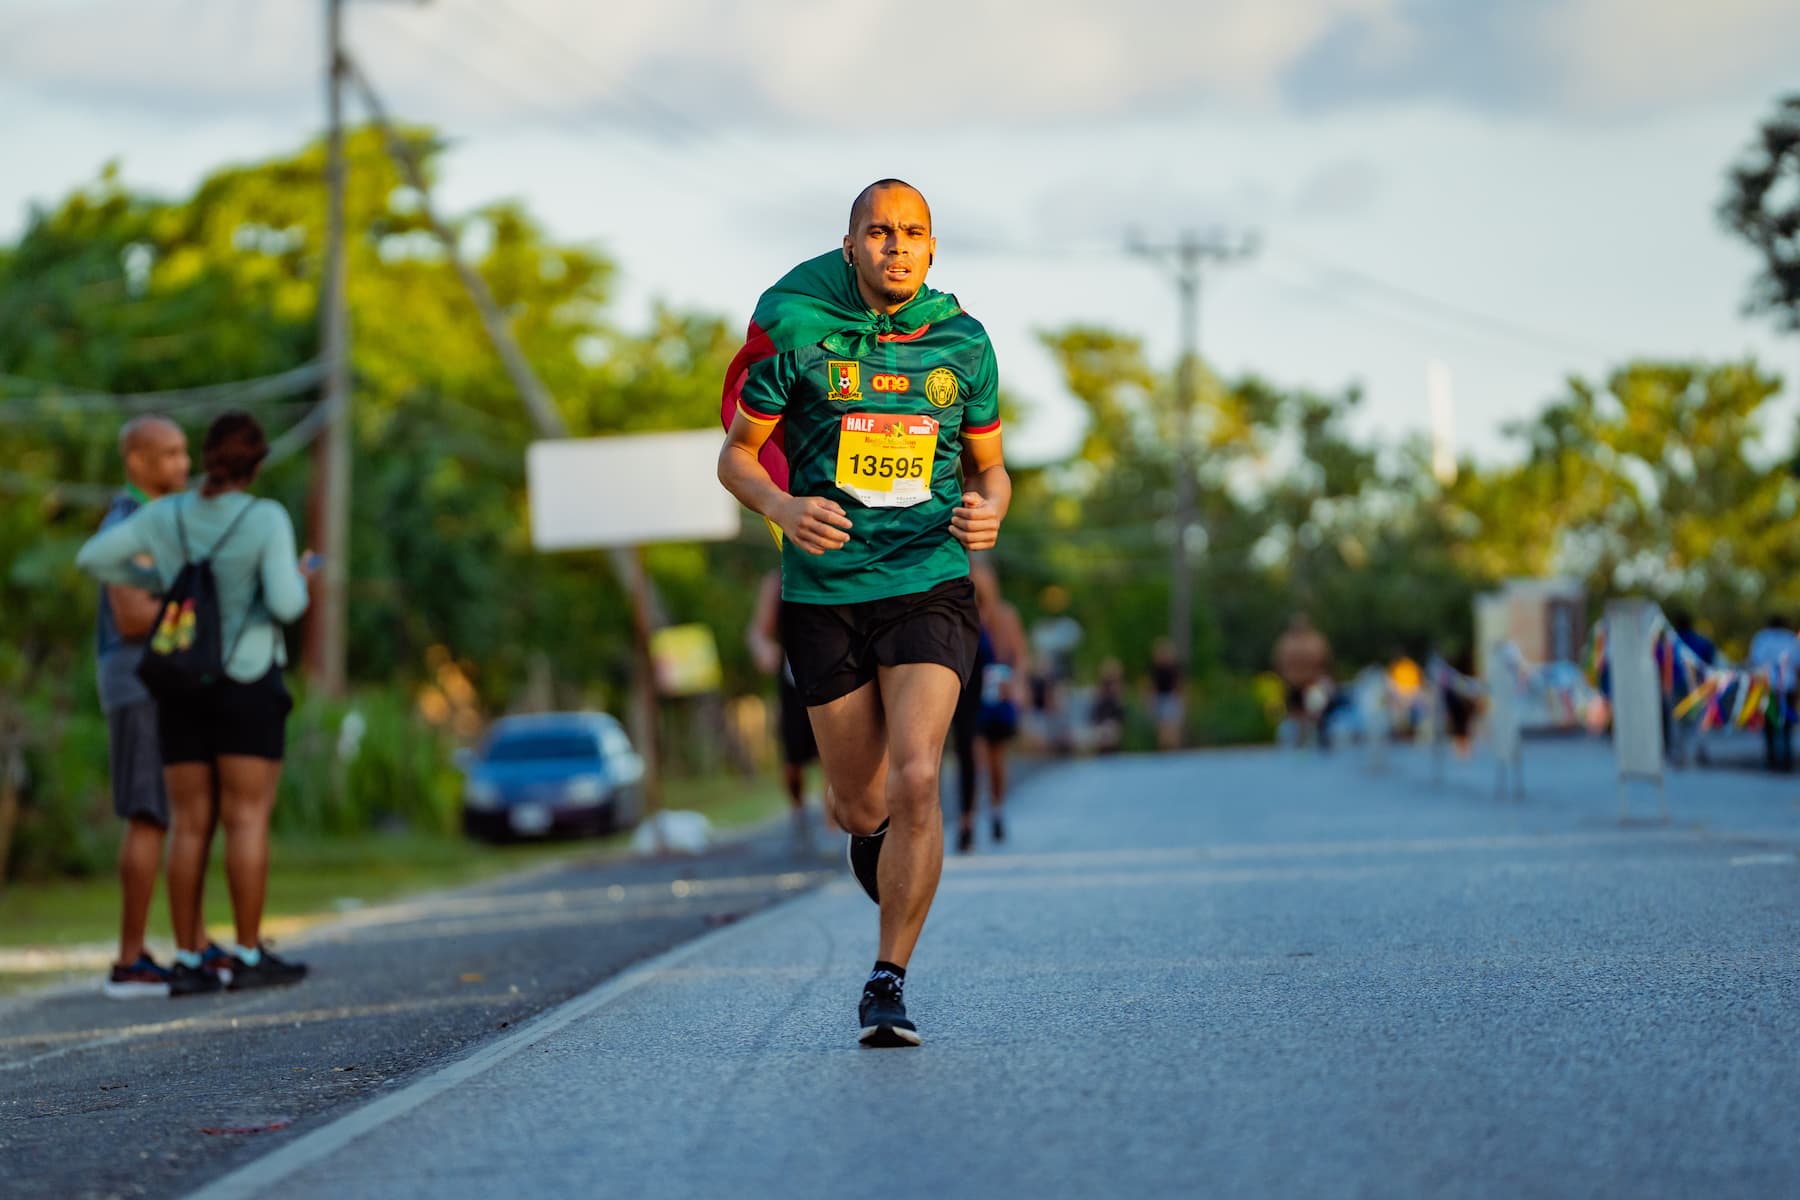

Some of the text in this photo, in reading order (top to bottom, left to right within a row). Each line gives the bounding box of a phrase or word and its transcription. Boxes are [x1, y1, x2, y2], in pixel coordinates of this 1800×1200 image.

[873, 375, 909, 391] one
[846, 417, 875, 432] HALF
[849, 454, 923, 478] 13595
